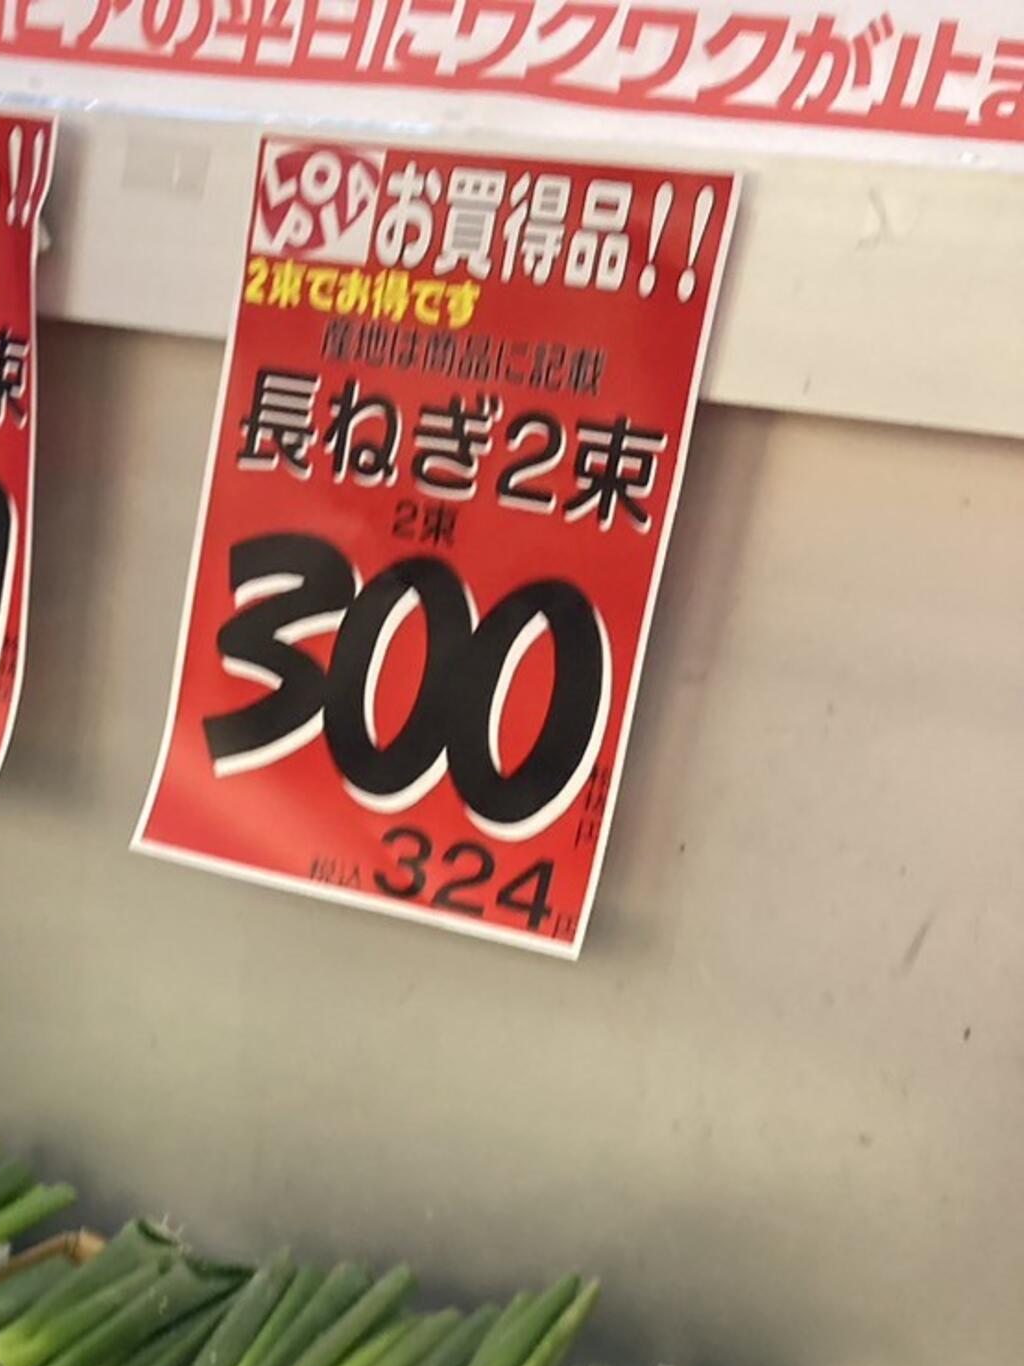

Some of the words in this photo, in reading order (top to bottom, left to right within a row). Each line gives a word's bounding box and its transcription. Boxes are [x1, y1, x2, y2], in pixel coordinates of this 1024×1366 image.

[244, 257, 481, 329] 2束でお得です
[237, 365, 668, 535] 長ねぎ2束
[202, 531, 613, 842] 300
[372, 826, 556, 931] 324
